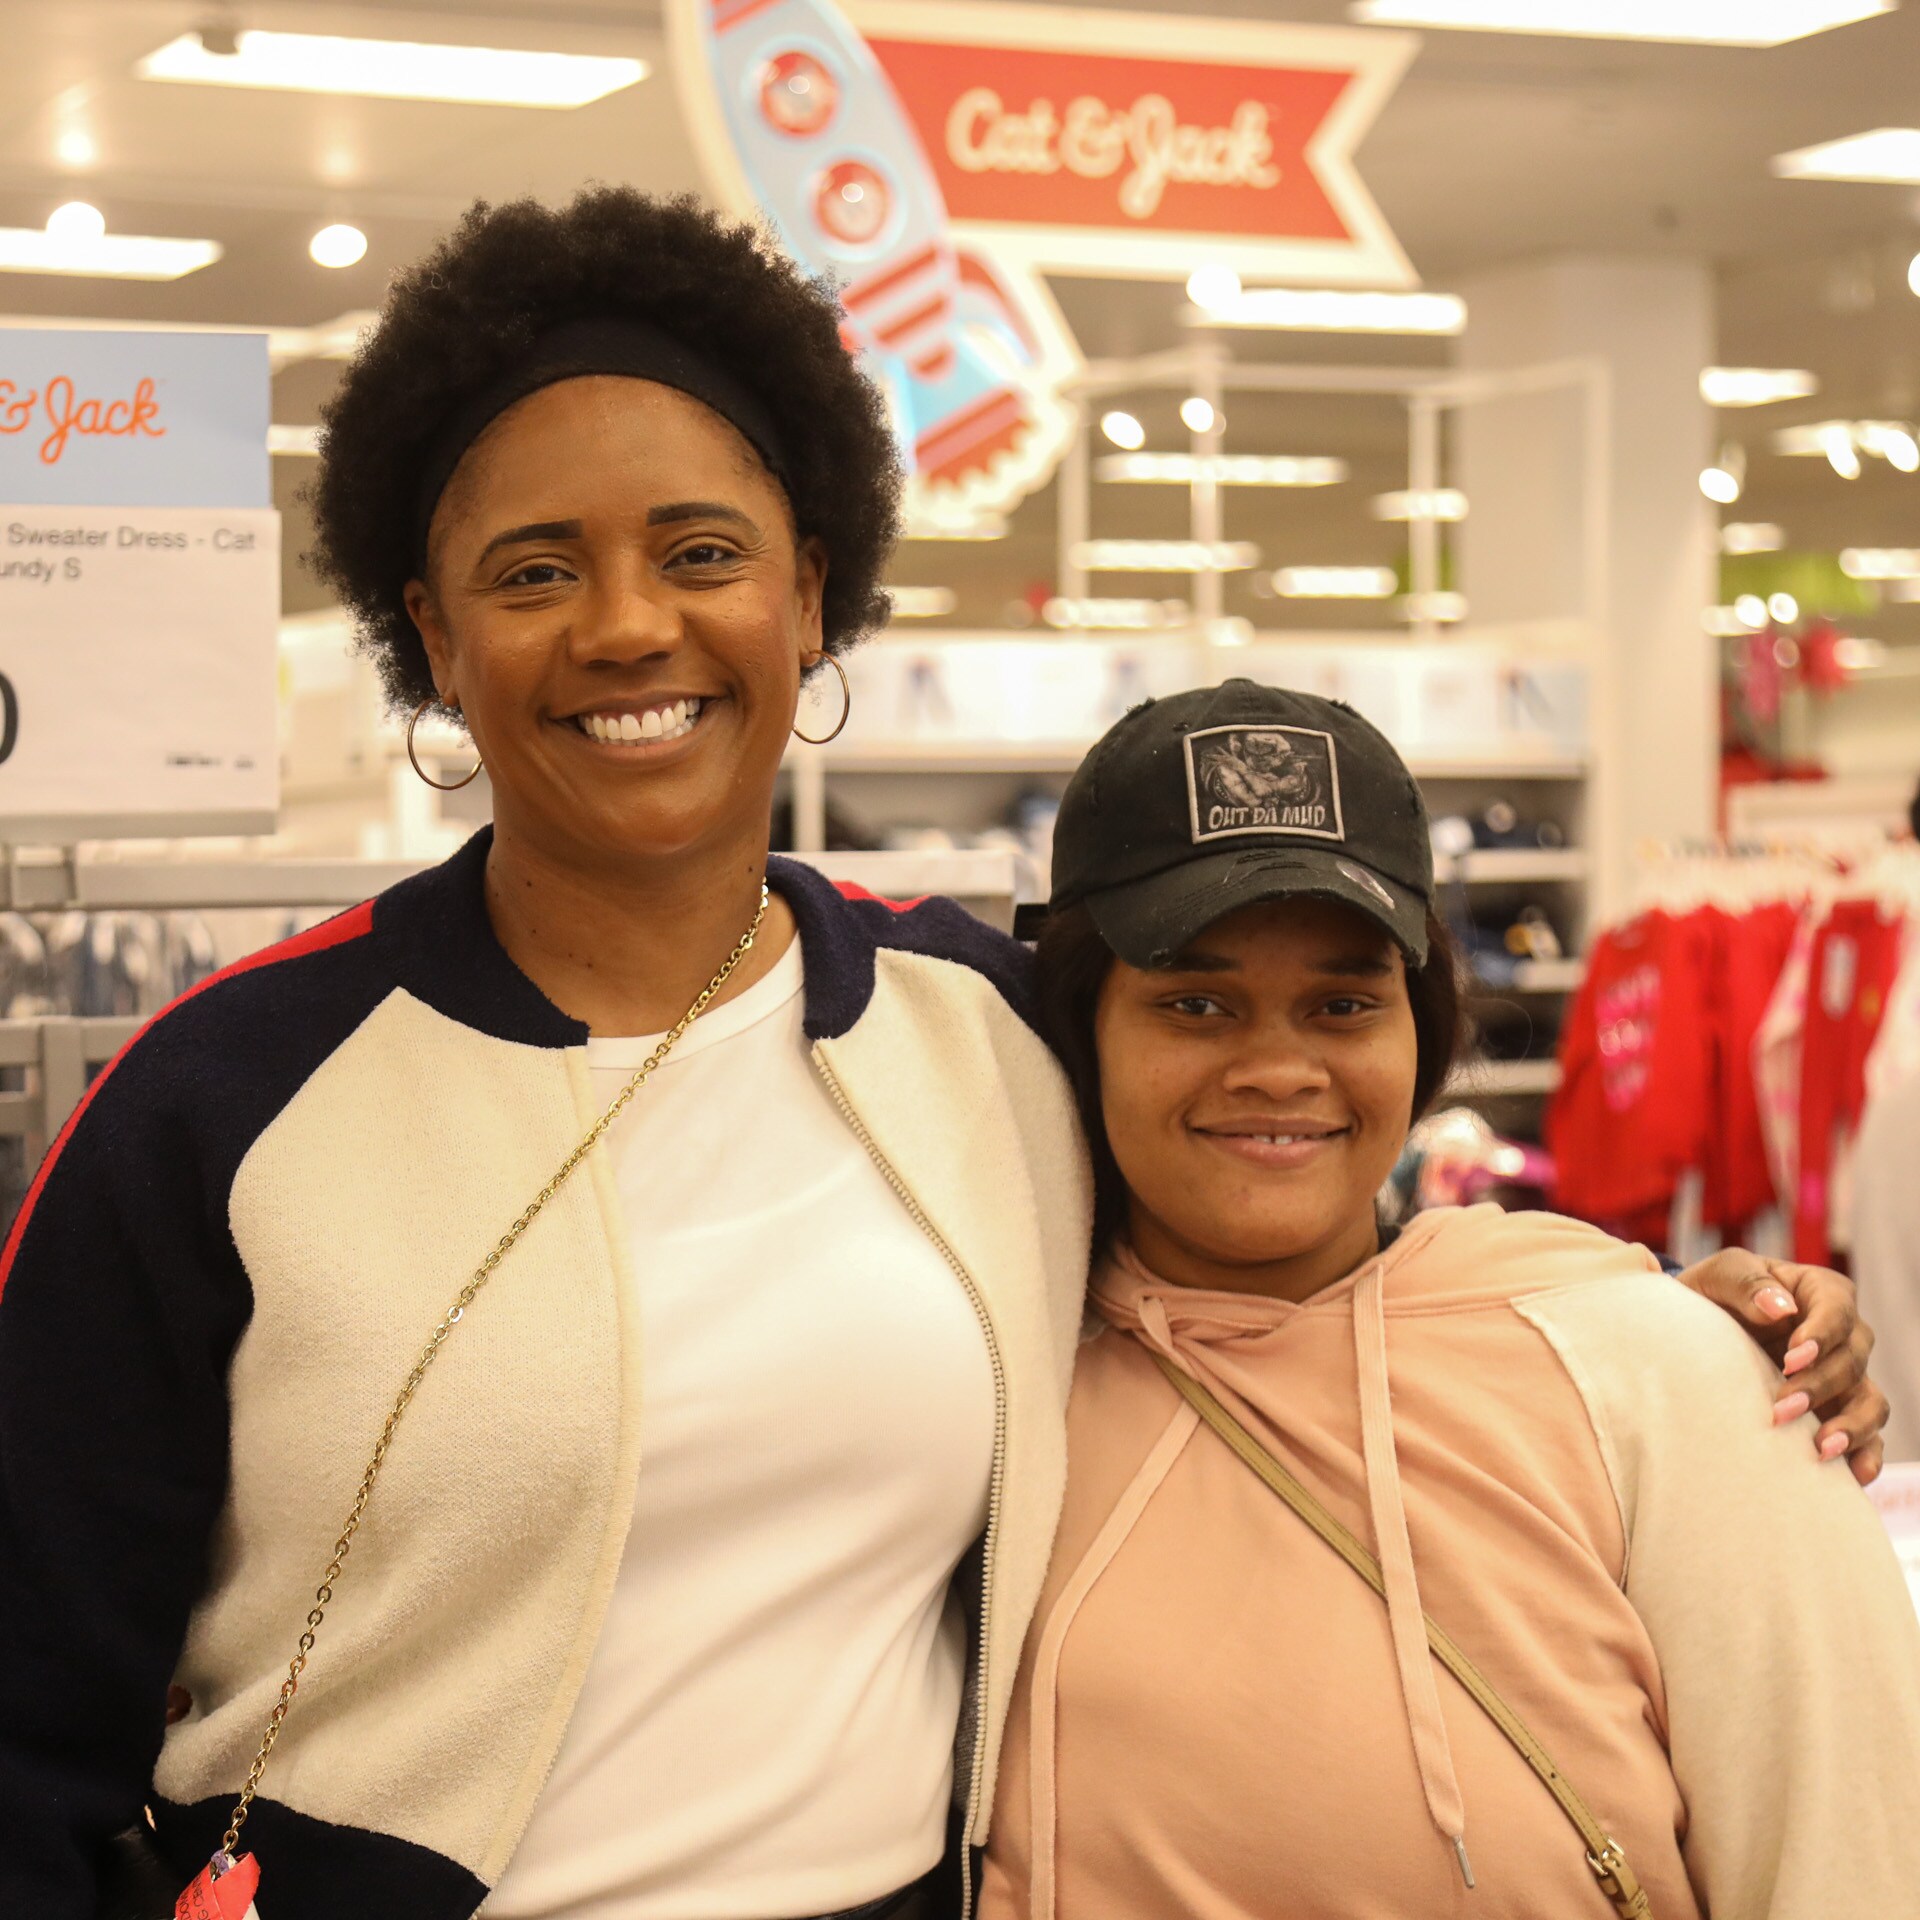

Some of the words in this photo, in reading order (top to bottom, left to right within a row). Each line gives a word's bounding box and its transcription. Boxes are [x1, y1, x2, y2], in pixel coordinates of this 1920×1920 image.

[946, 86, 1061, 175] Cat
[1117, 93, 1282, 219] Jack
[39, 375, 166, 464] Jack
[7, 522, 109, 547] Sweater
[117, 525, 188, 549] Dress
[212, 528, 256, 551] Cat
[63, 556, 82, 580] S
[1208, 805, 1249, 830] OUT
[1252, 806, 1278, 825] DA
[1281, 805, 1326, 827] MUD
